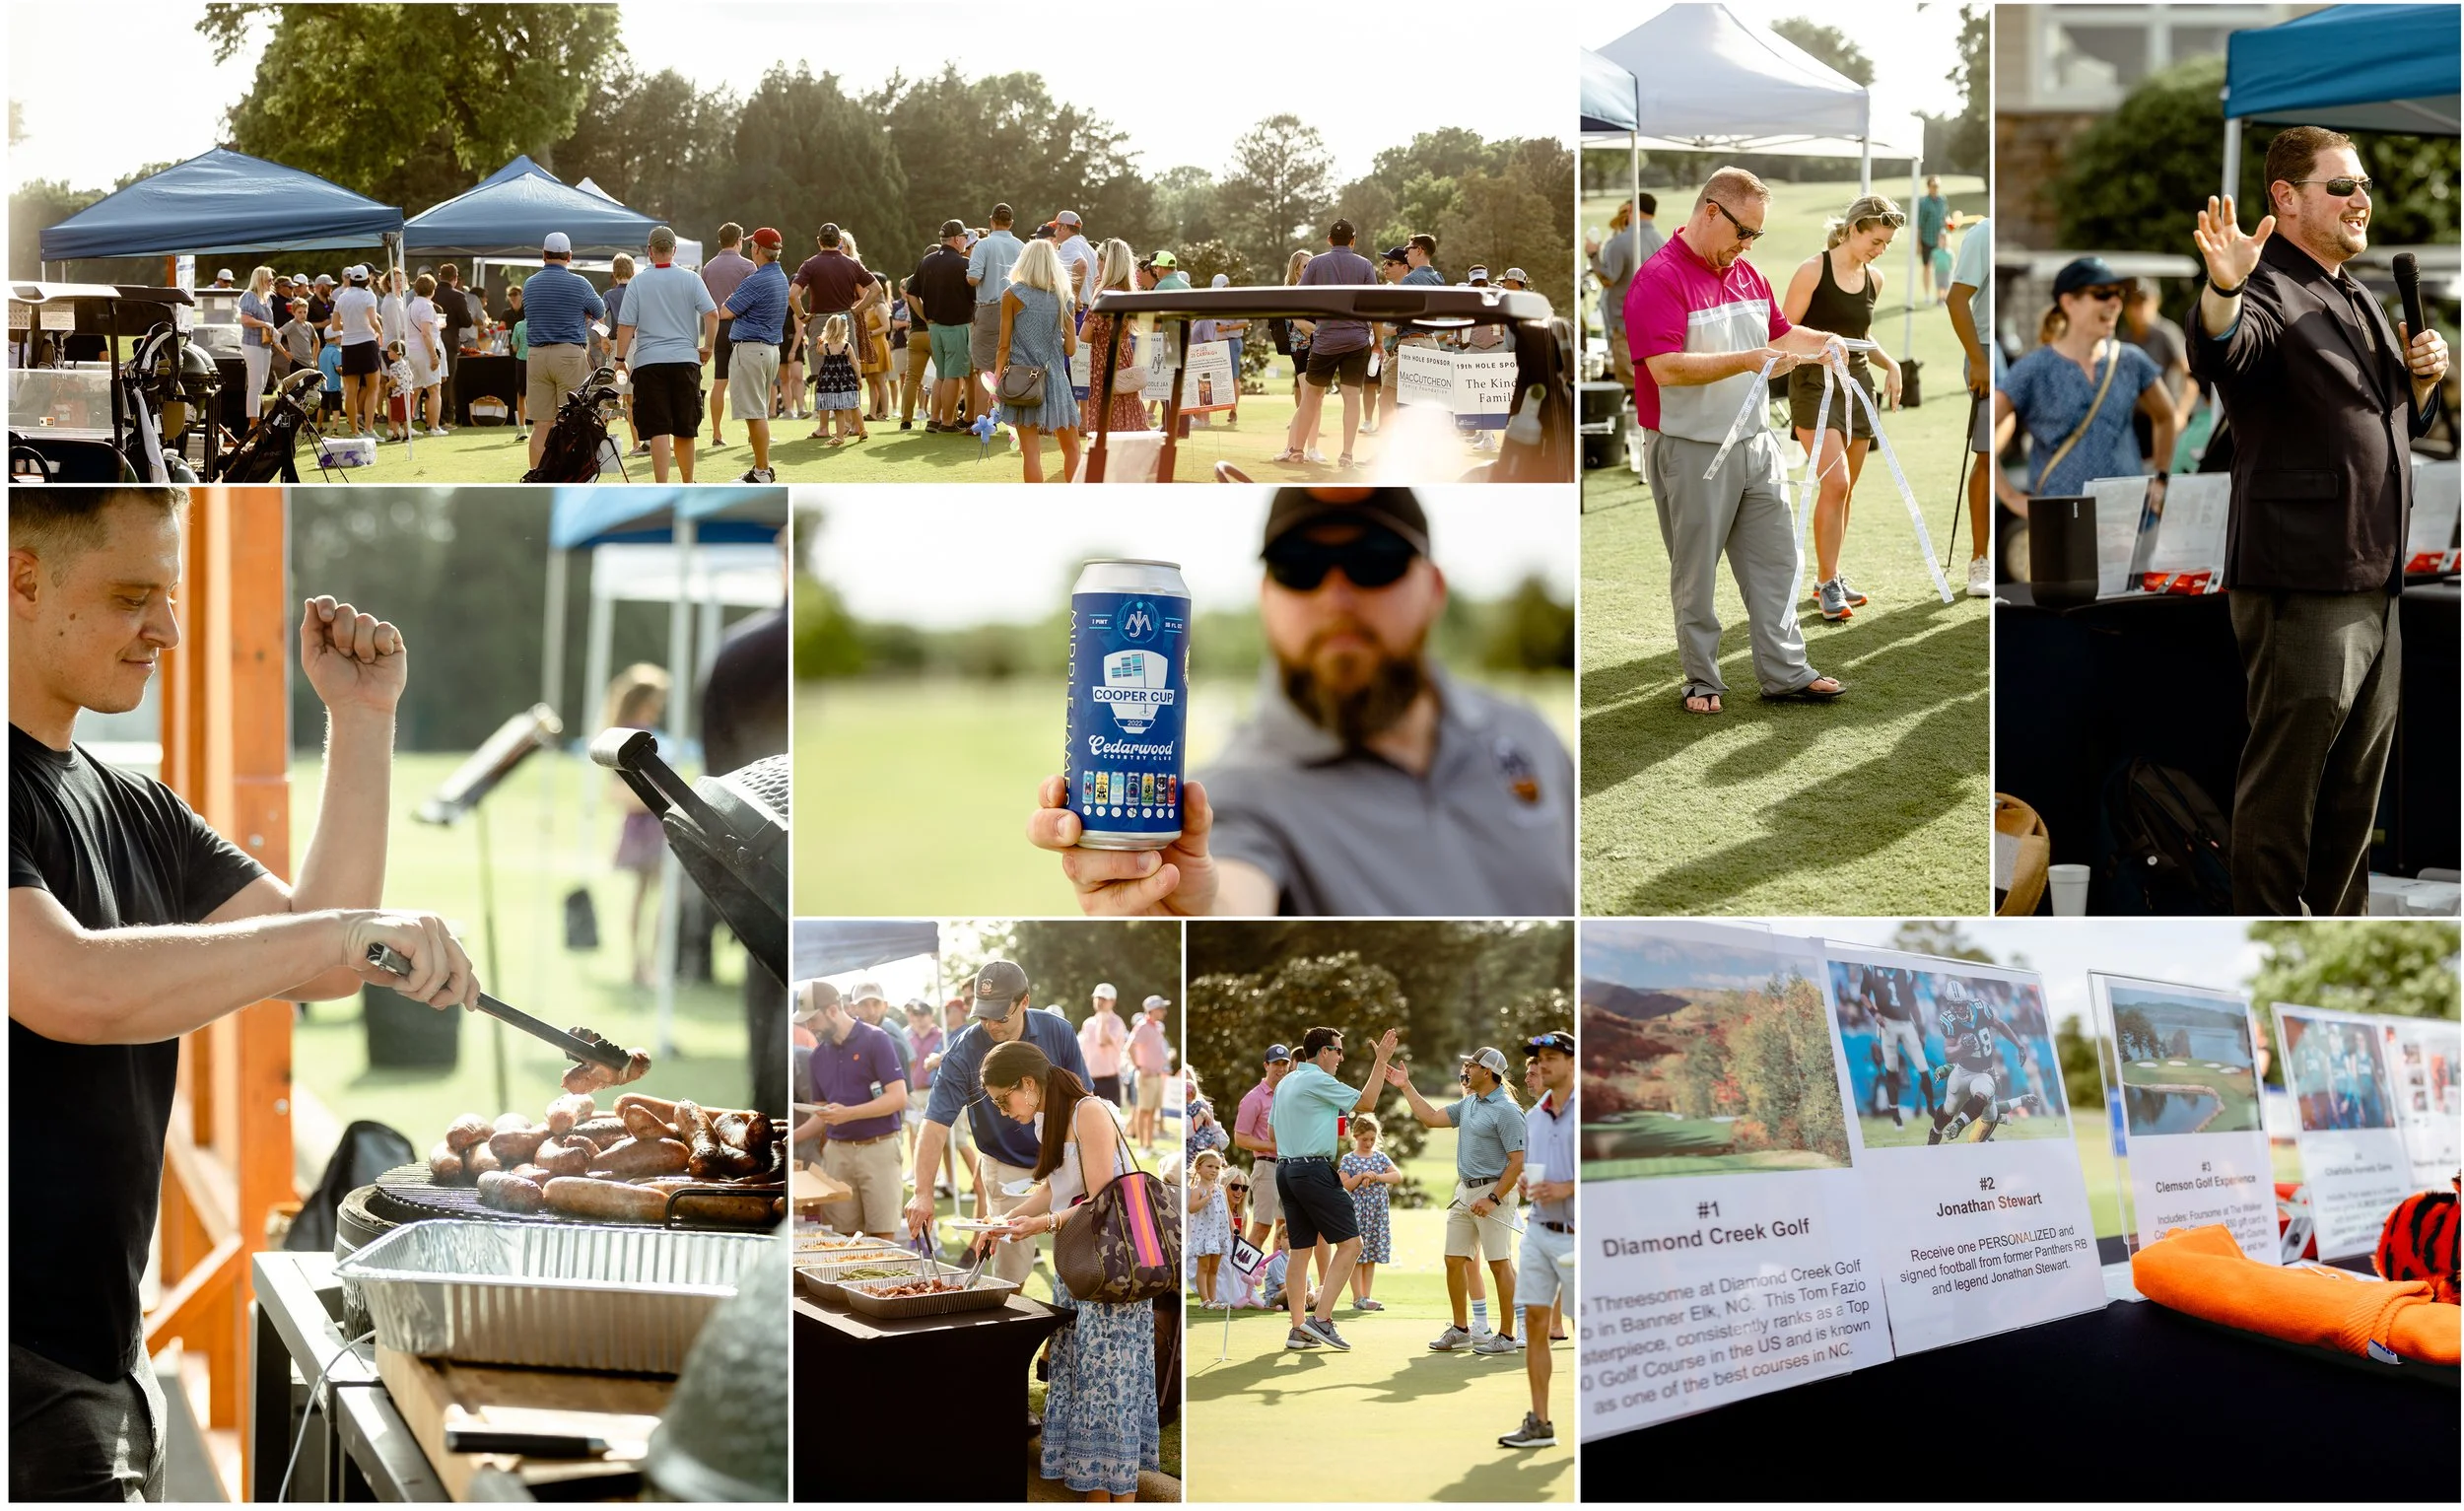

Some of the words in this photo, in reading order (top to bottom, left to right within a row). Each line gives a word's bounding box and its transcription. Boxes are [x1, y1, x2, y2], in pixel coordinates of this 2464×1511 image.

[1426, 357, 1451, 367] SPONSOR
[1466, 378, 1486, 388] The
[1490, 378, 1518, 388] Kind
[1478, 392, 1514, 402] Famil
[1094, 689, 1147, 702] COOPER
[1150, 692, 1173, 703] CUP
[1088, 734, 1174, 756] Cedarwood
[2202, 1161, 2212, 1173] #3
[1979, 1177, 1995, 1191] #2
[2156, 1181, 2194, 1193] Clemson
[2196, 1177, 2213, 1189] Golf
[2215, 1174, 2256, 1187] Experience
[1697, 1201, 1721, 1220] #1
[1936, 1198, 1995, 1217] Jonathan
[1997, 1193, 2042, 1209] Stewart
[2156, 1212, 2187, 1225] Includes:
[2190, 1207, 2222, 1220] Foursome
[2229, 1204, 2241, 1214] The
[1602, 1230, 1703, 1258] Diamond
[1709, 1222, 1768, 1246] Creek
[1772, 1218, 1810, 1237] Golf
[1910, 1244, 1955, 1262] Receive
[1957, 1242, 1977, 1255] one
[1978, 1227, 2057, 1251] PERSONALIZED
[2058, 1225, 2074, 1237] and
[1900, 1266, 1937, 1283] signed
[1939, 1258, 1977, 1276] football
[1979, 1254, 2002, 1269] from
[2003, 1250, 2033, 1264] former
[2034, 1240, 2074, 1259] Panthers
[2074, 1238, 2088, 1252] RB
[1591, 1286, 1695, 1314] Threesome
[1699, 1281, 1716, 1297] at
[1719, 1271, 1787, 1293] Diamond
[1790, 1265, 1833, 1281] Creek
[1835, 1260, 1862, 1275] Golf
[1932, 1281, 1952, 1296] and
[1954, 1274, 1989, 1292] legend
[1991, 1266, 2034, 1283] Jonathan
[2035, 1258, 2071, 1275] Stewart.
[1599, 1321, 1616, 1337] in
[1620, 1309, 1685, 1335] Banner
[1689, 1303, 1722, 1322] Elk,
[1725, 1297, 1756, 1315] NC.
[1764, 1291, 1796, 1308] This
[1798, 1286, 1828, 1301] Tom
[1831, 1279, 1867, 1296] Fazio
[1581, 1339, 1672, 1366] sterpiece,
[1676, 1317, 1768, 1347] consistently
[1774, 1310, 1813, 1329] ranks
[1816, 1307, 1833, 1321] as
[1836, 1305, 1845, 1317] a
[1846, 1299, 1870, 1314] Top
[1599, 1364, 1639, 1388] Golf
[1642, 1354, 1705, 1378] Course
[1709, 1348, 1725, 1364] in
[1729, 1342, 1754, 1360] the
[1758, 1336, 1782, 1353] US
[1786, 1331, 1812, 1348] and
[1815, 1327, 1827, 1340] is
[1830, 1320, 1871, 1339] known
[1593, 1398, 1618, 1415] as
[1620, 1388, 1658, 1408] one
[1662, 1381, 1679, 1399] of
[1683, 1376, 1710, 1394] the
[1713, 1366, 1748, 1386] best
[1752, 1354, 1810, 1378] courses
[1813, 1348, 1825, 1363] in
[1828, 1342, 1853, 1359] NC.
